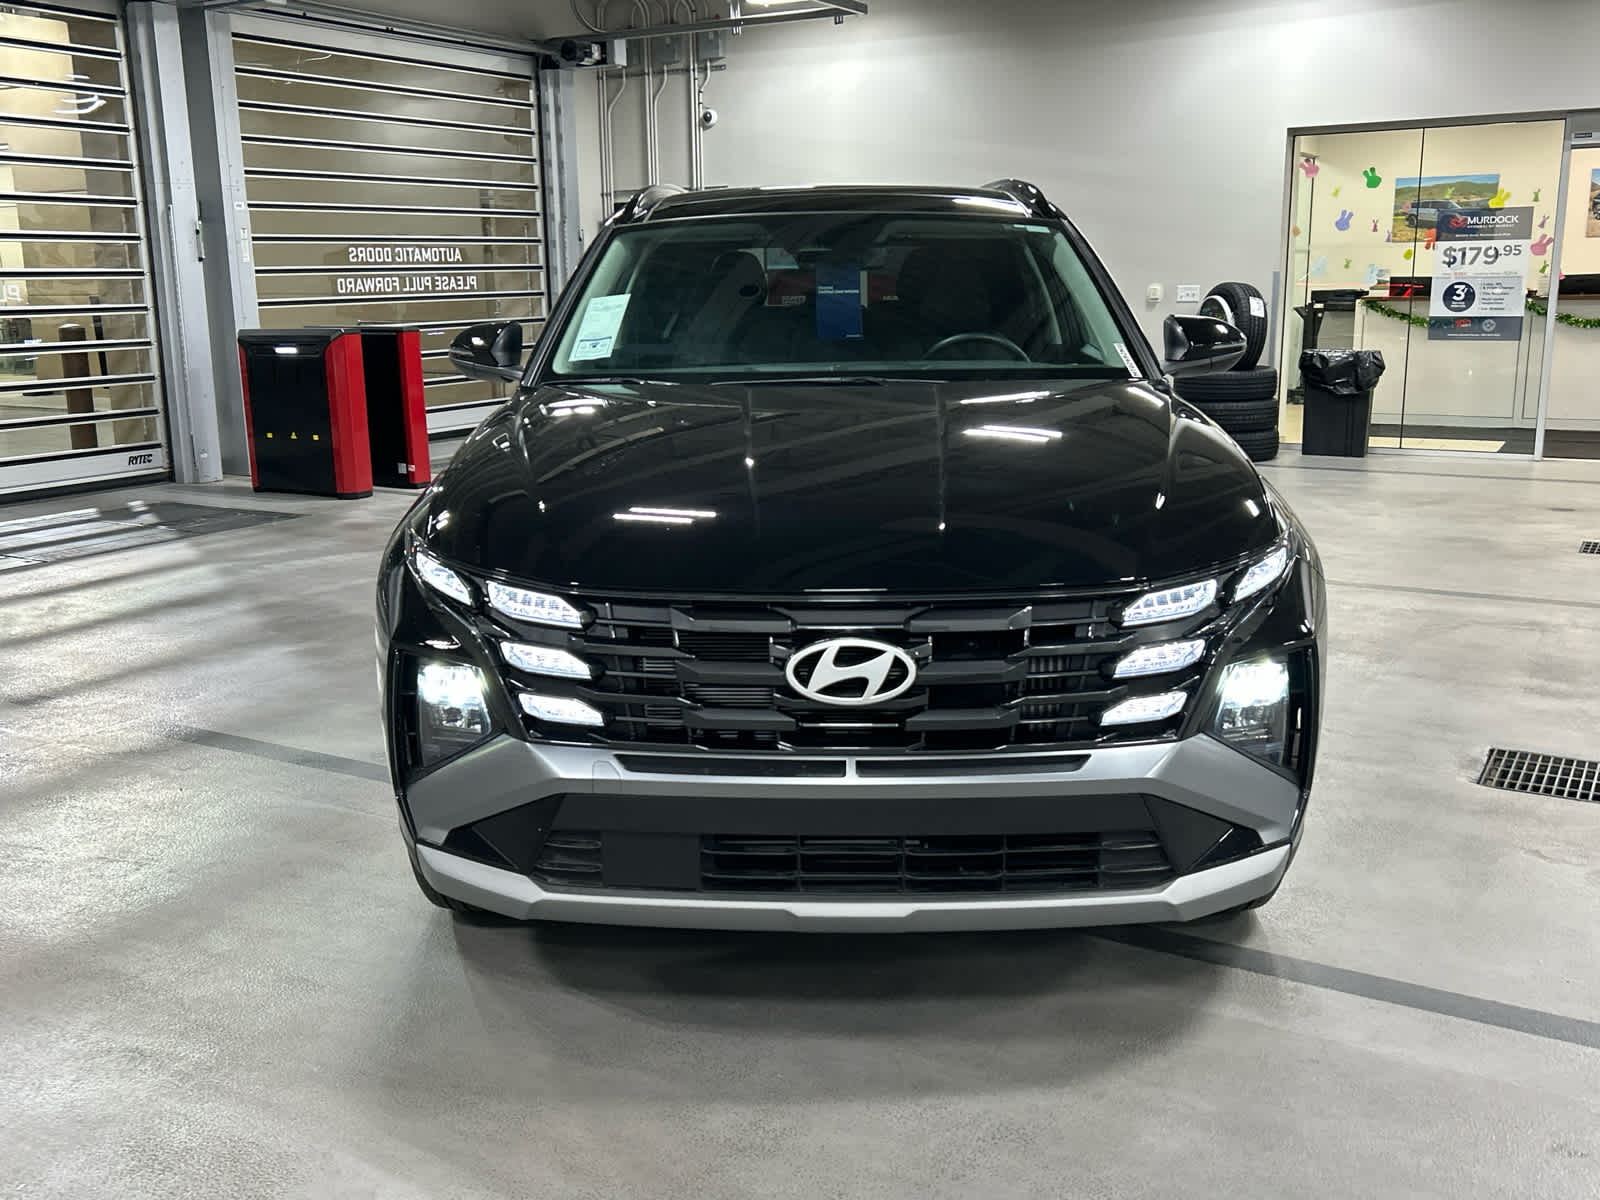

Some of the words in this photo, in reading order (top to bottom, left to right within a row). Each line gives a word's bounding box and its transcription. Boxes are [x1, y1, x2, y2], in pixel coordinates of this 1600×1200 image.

[1467, 215, 1519, 225] MURDOCK
[1442, 244, 1522, 268] $179.95
[128, 454, 153, 466] RYTEC
